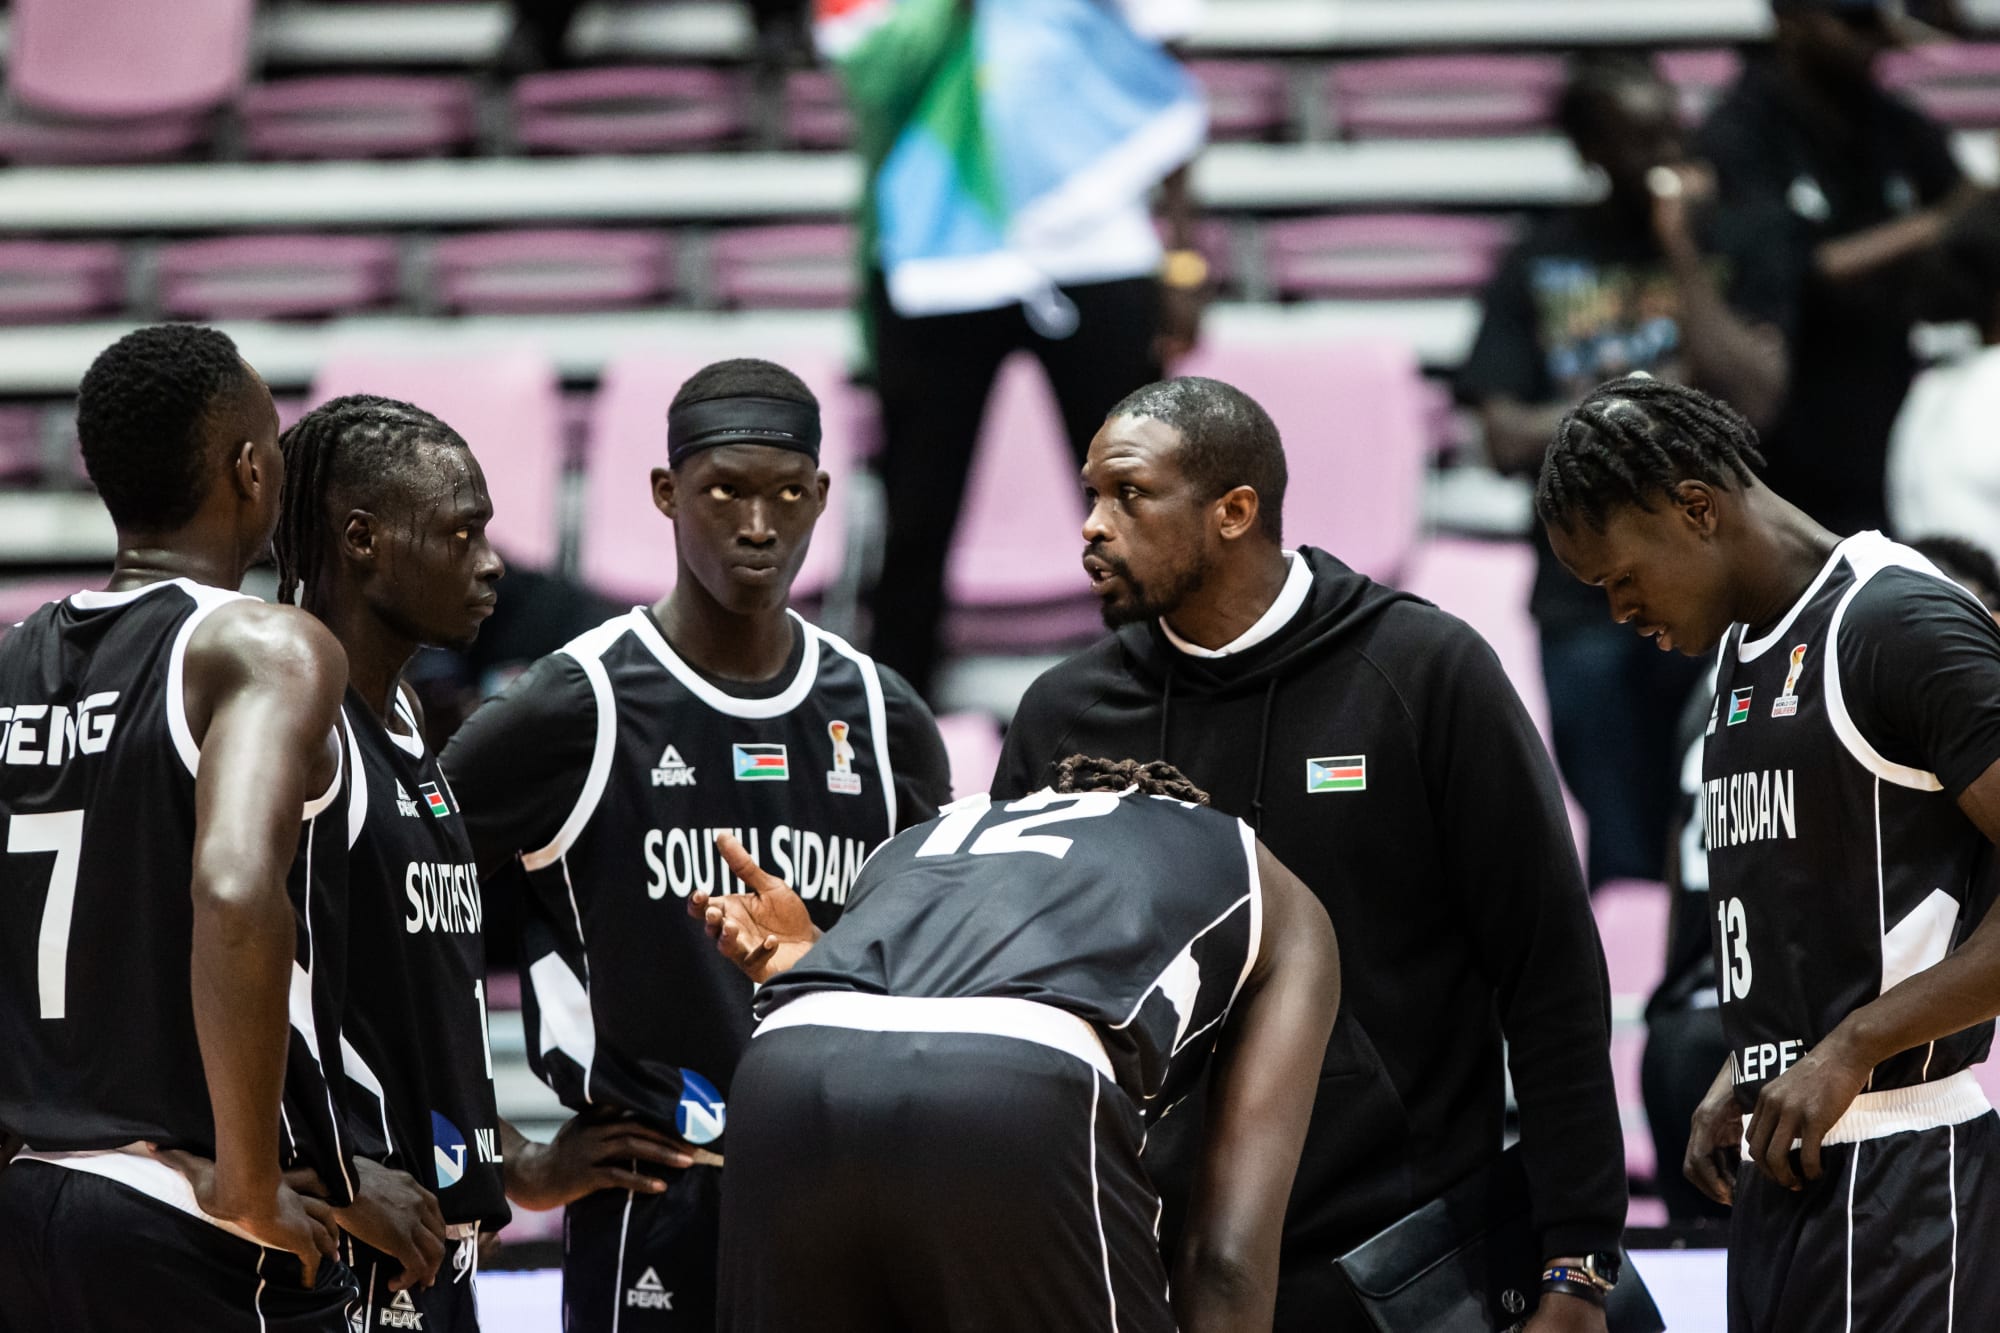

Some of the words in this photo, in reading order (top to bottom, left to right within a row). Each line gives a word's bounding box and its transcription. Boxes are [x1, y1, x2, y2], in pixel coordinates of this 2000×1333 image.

[651, 767, 697, 786] PEAK
[1730, 769, 1796, 846] SUDAN
[7, 809, 85, 1019] 7
[1718, 897, 1752, 1003] 13
[380, 1307, 424, 1331] PEAK
[627, 1289, 673, 1310] PEAK
